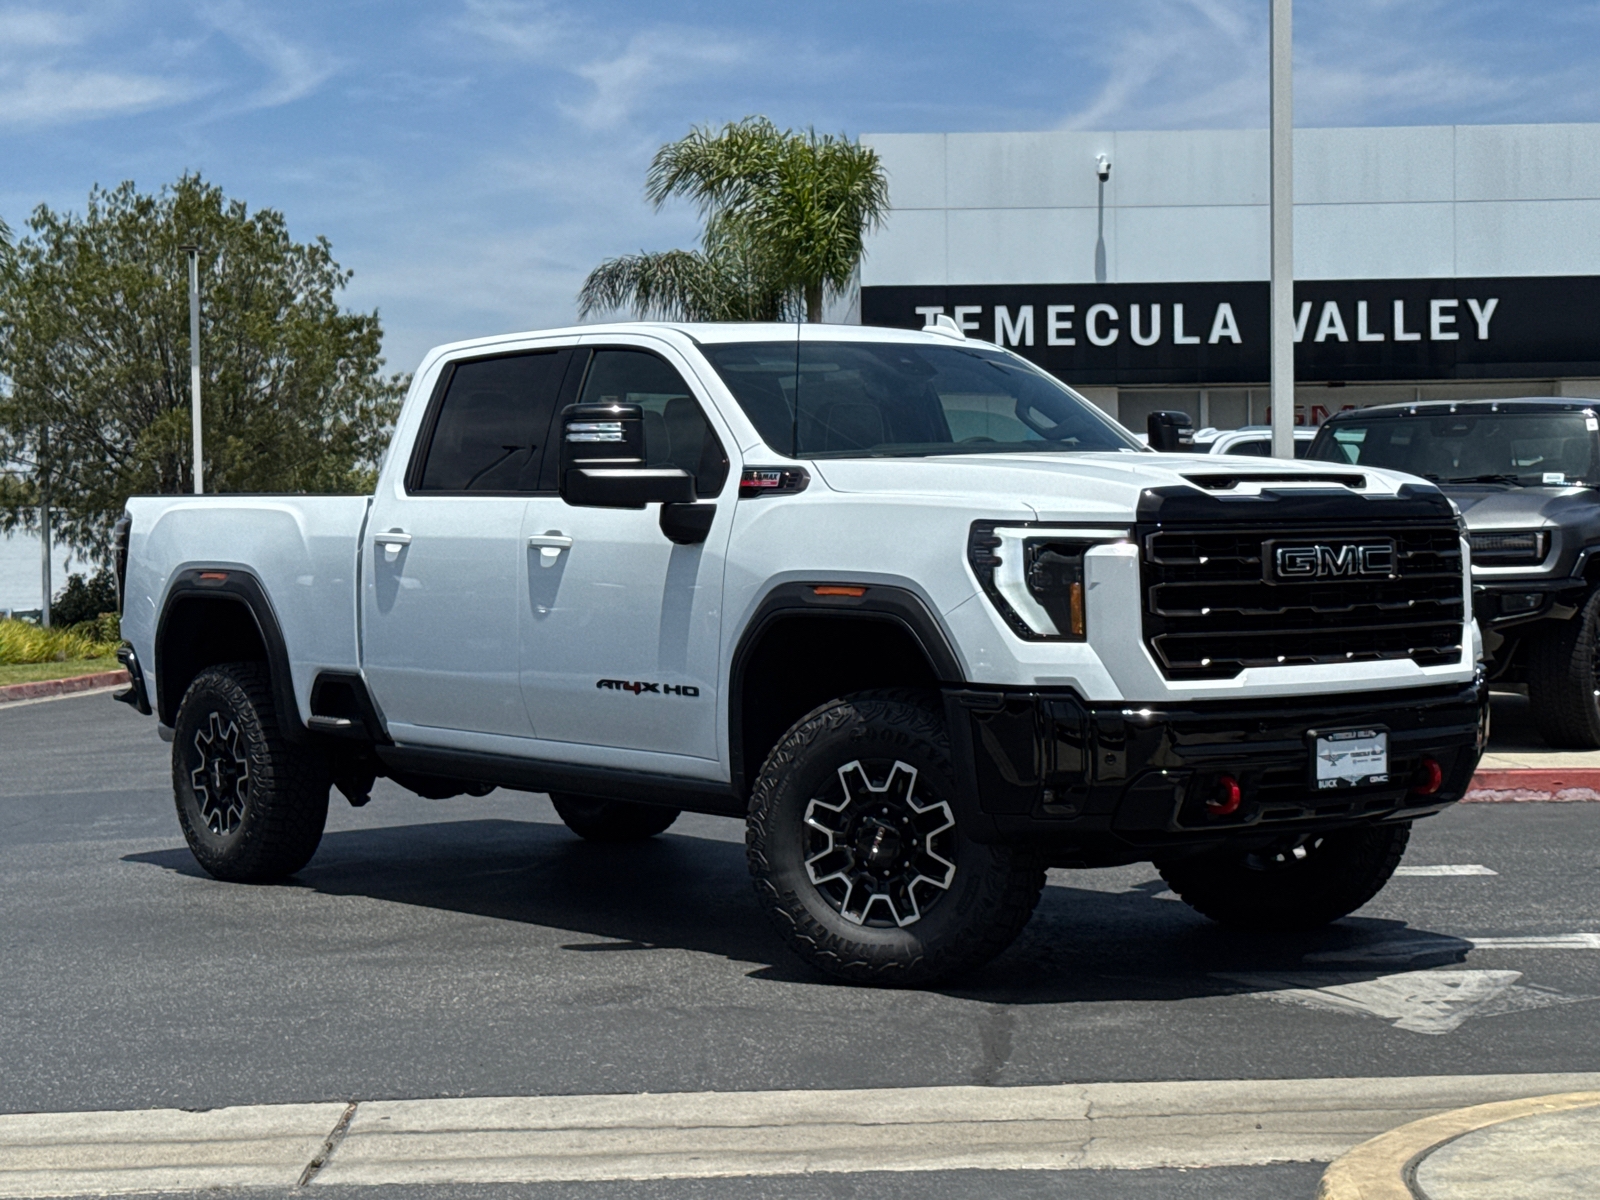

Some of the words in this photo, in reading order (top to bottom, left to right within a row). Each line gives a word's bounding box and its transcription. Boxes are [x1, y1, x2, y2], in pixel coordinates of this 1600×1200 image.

[915, 303, 1243, 347] TEMECULA
[1294, 298, 1499, 343] VALLEY
[1276, 545, 1393, 577] GMC
[596, 679, 660, 695] AT4X
[663, 683, 700, 697] HD
